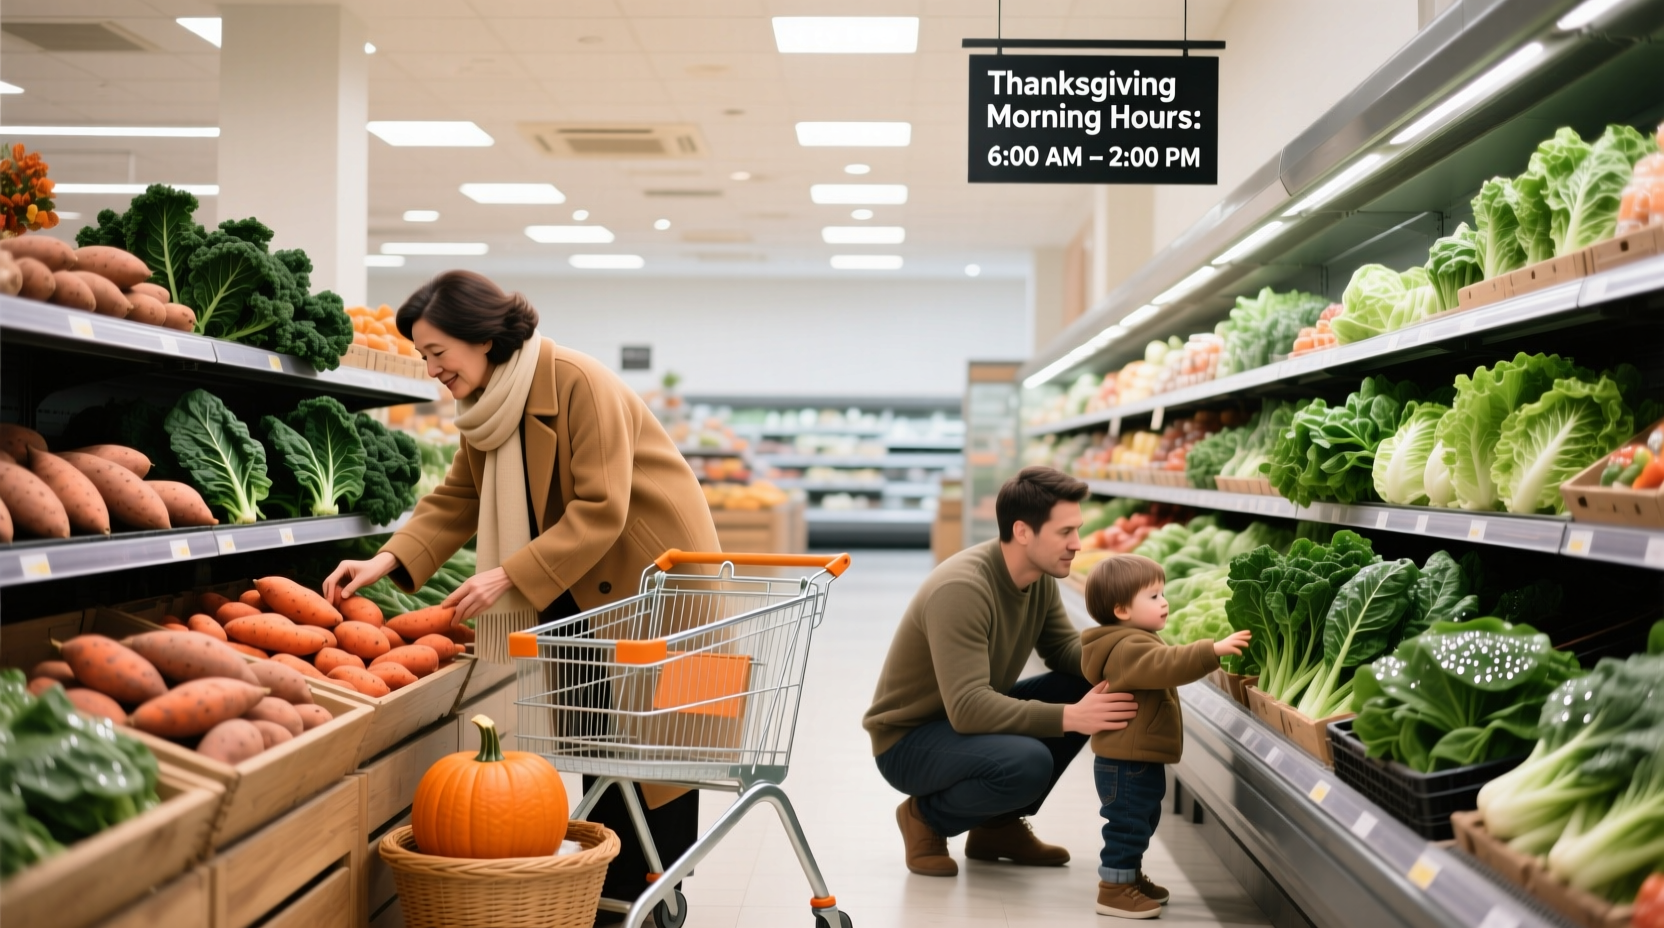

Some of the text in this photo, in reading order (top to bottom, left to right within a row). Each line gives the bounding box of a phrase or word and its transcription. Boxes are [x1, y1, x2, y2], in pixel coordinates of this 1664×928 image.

[987, 70, 1176, 102] Thanksgiving
[987, 103, 1201, 135] Morning Hours:
[987, 145, 1039, 167] 6:00
[1045, 146, 1082, 167] AM
[1108, 146, 1159, 168] 2:00
[1165, 147, 1200, 168] PM
